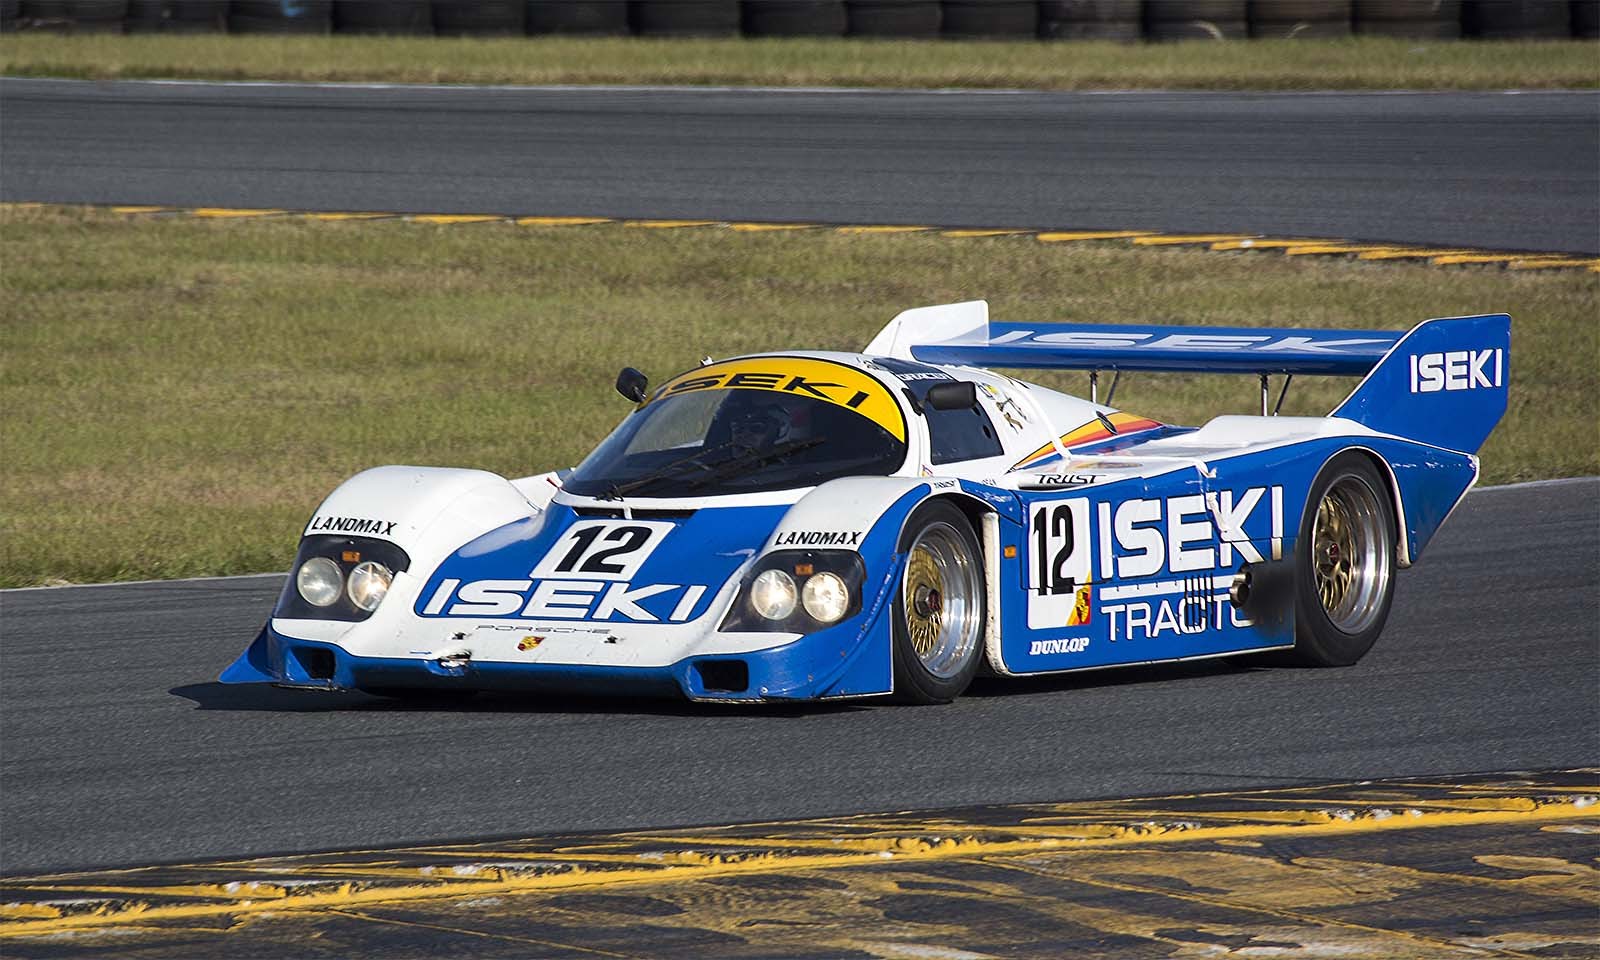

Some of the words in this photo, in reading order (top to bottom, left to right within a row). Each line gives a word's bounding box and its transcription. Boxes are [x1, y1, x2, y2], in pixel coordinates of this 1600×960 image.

[988, 330, 1396, 354] ISEK
[1410, 348, 1503, 393] ISEKI
[1036, 474, 1104, 485] TRUST
[311, 516, 399, 537] LANDMAX
[774, 531, 864, 547] LANDMAX
[1098, 486, 1283, 579] ISEKI
[554, 525, 653, 574] 12
[1033, 504, 1075, 596] 12
[423, 578, 707, 621] ISEKI
[474, 624, 612, 635] PORSCHE
[1101, 594, 1284, 642] TRACT
[1029, 637, 1091, 656] DUNLOP
